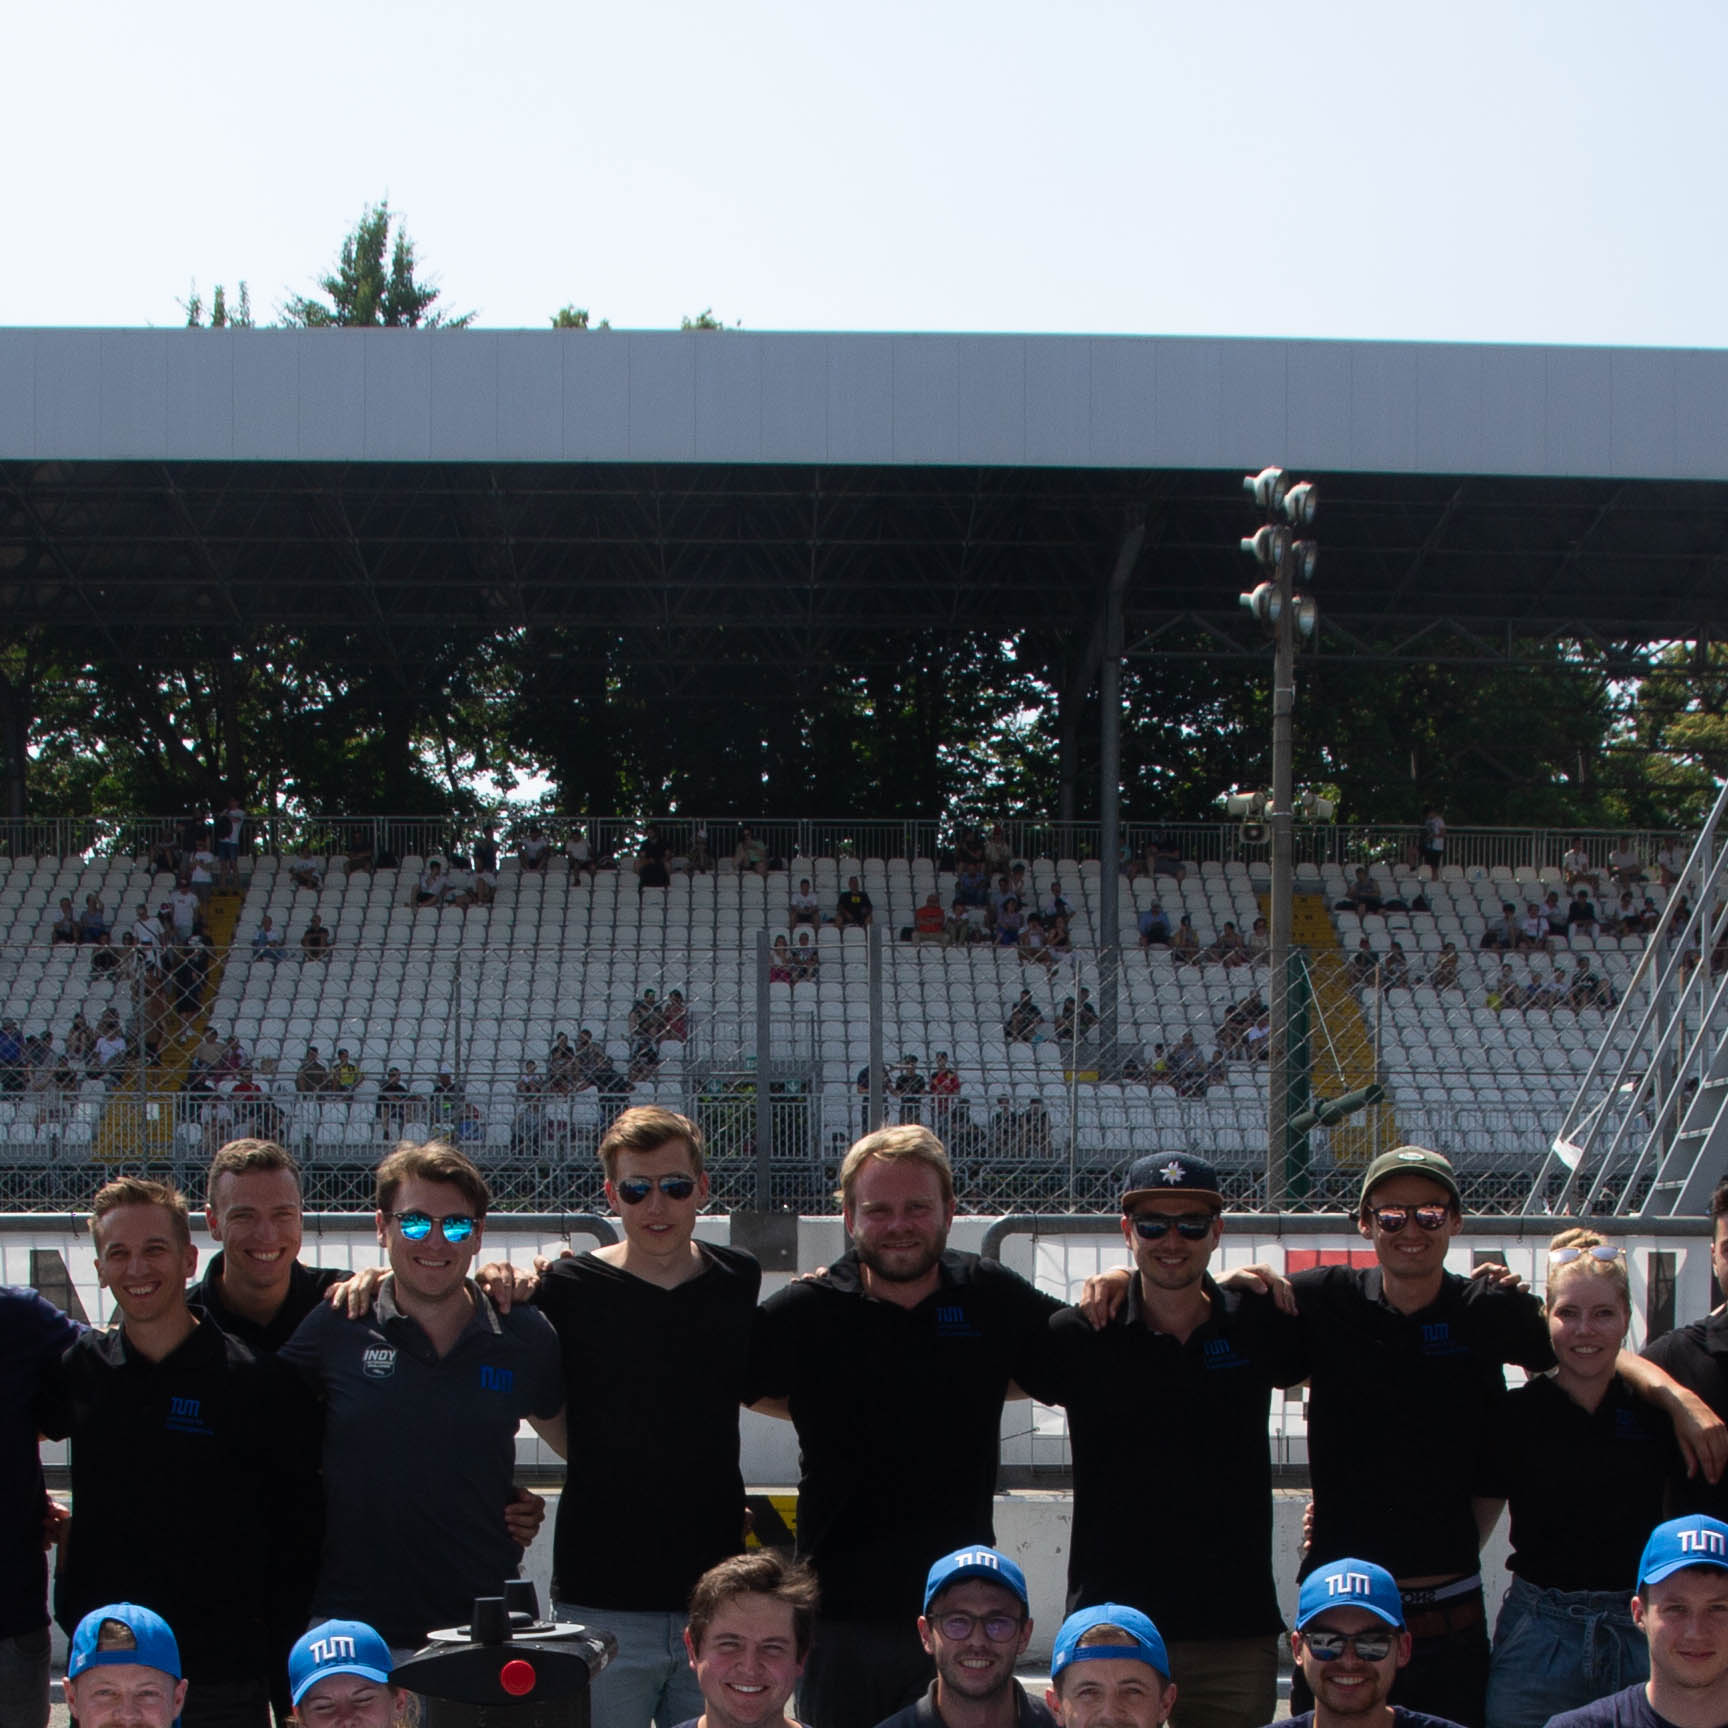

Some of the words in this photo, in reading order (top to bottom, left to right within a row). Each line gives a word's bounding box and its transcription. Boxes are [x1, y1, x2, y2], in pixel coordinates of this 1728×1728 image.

[363, 1349, 396, 1362] INDY
[1677, 1529, 1726, 1555] TUM
[1325, 1573, 1370, 1597] TUM
[309, 1637, 355, 1662] TUM
